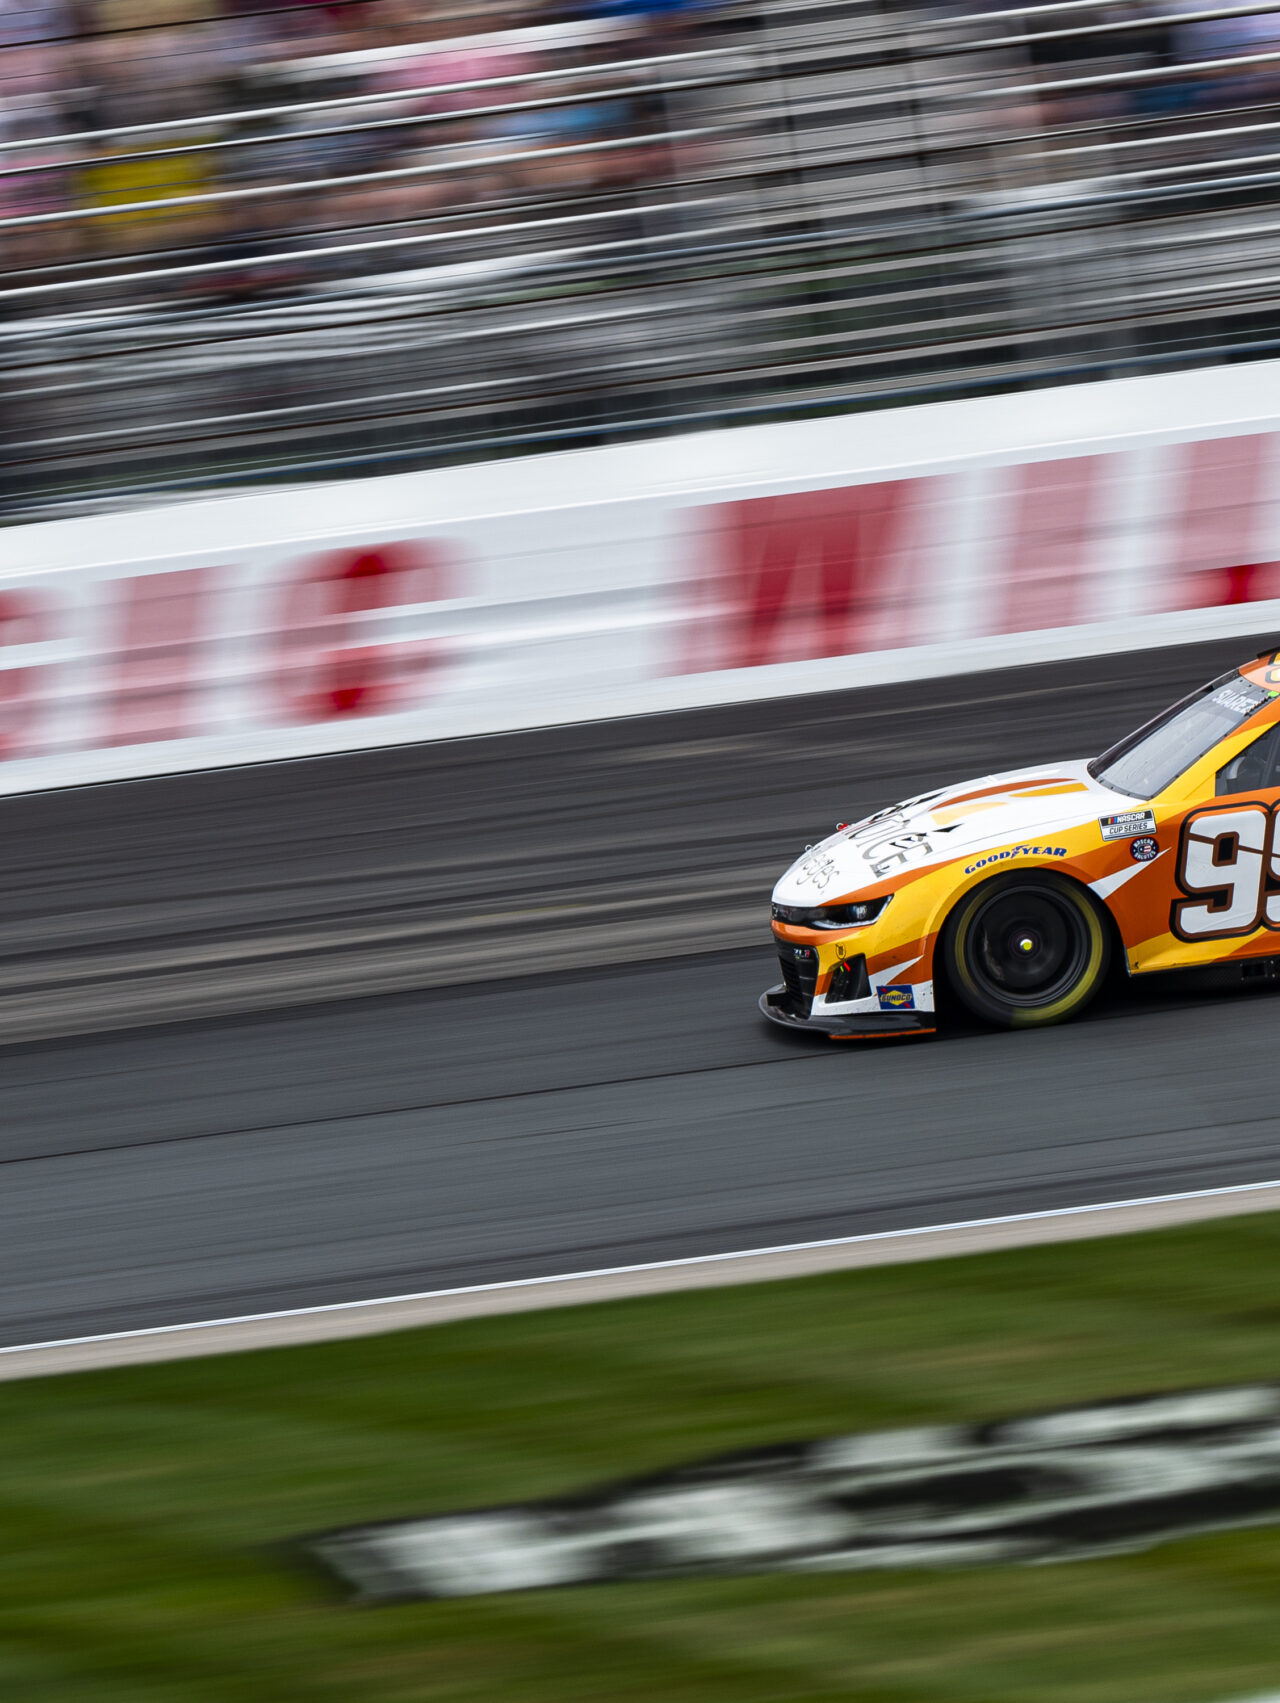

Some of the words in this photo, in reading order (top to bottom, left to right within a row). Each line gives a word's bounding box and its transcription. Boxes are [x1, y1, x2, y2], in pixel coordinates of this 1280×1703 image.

[1116, 812, 1146, 824] NASCAR
[1109, 825, 1124, 835] CUP
[1124, 822, 1148, 833] SERIES
[964, 844, 1068, 875] GOODYEAR
[880, 992, 912, 1003] SUNOCO
